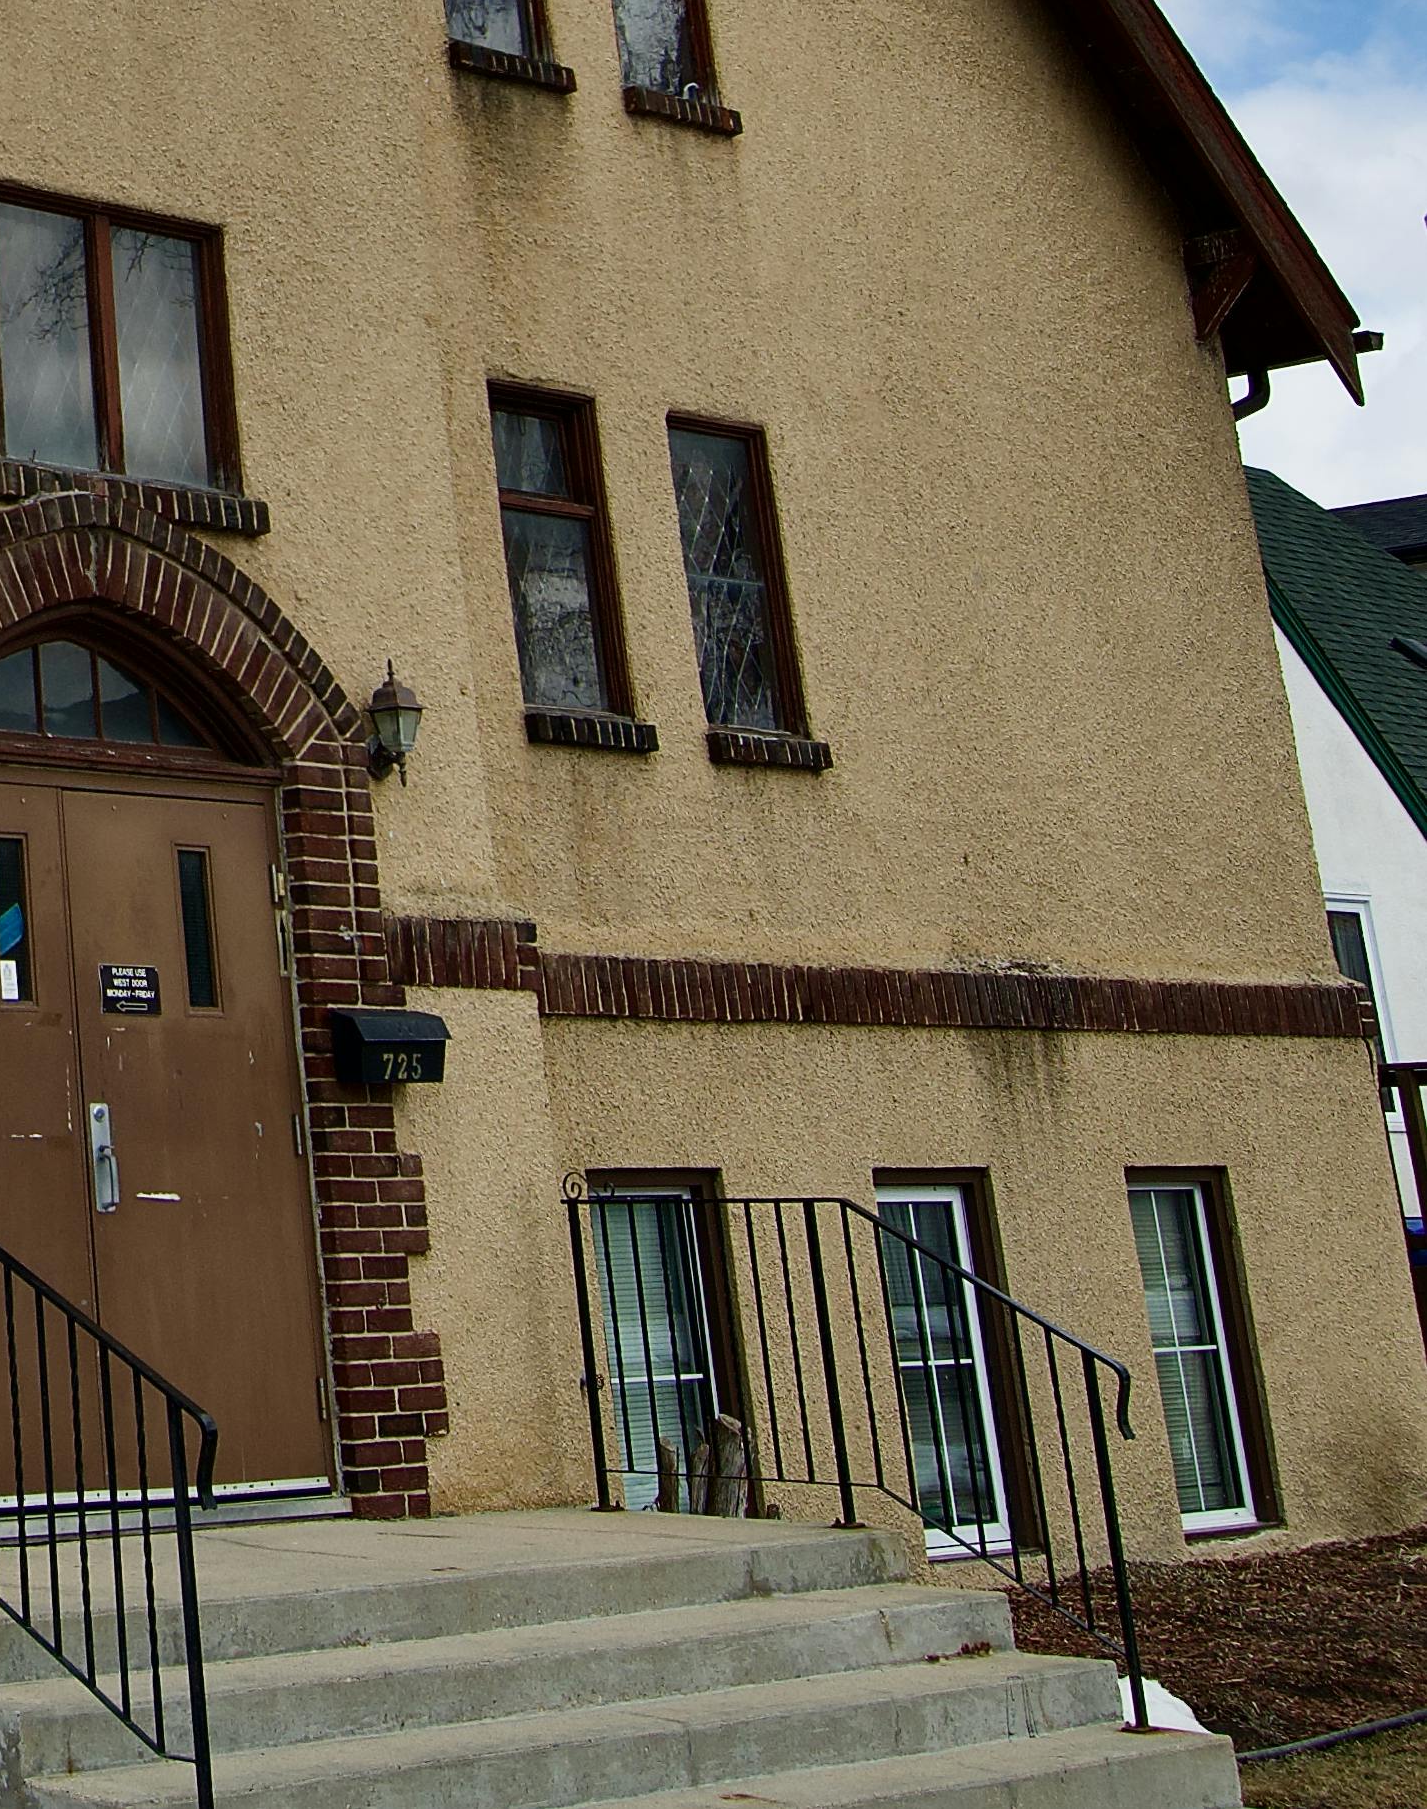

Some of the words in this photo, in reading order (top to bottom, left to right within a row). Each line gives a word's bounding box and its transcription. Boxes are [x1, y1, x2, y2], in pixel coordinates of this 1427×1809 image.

[112, 967, 134, 977] PLEASE
[135, 969, 147, 977] USE
[113, 978, 130, 987] WEST
[132, 979, 148, 988] DOOR
[383, 1053, 422, 1080] 725
